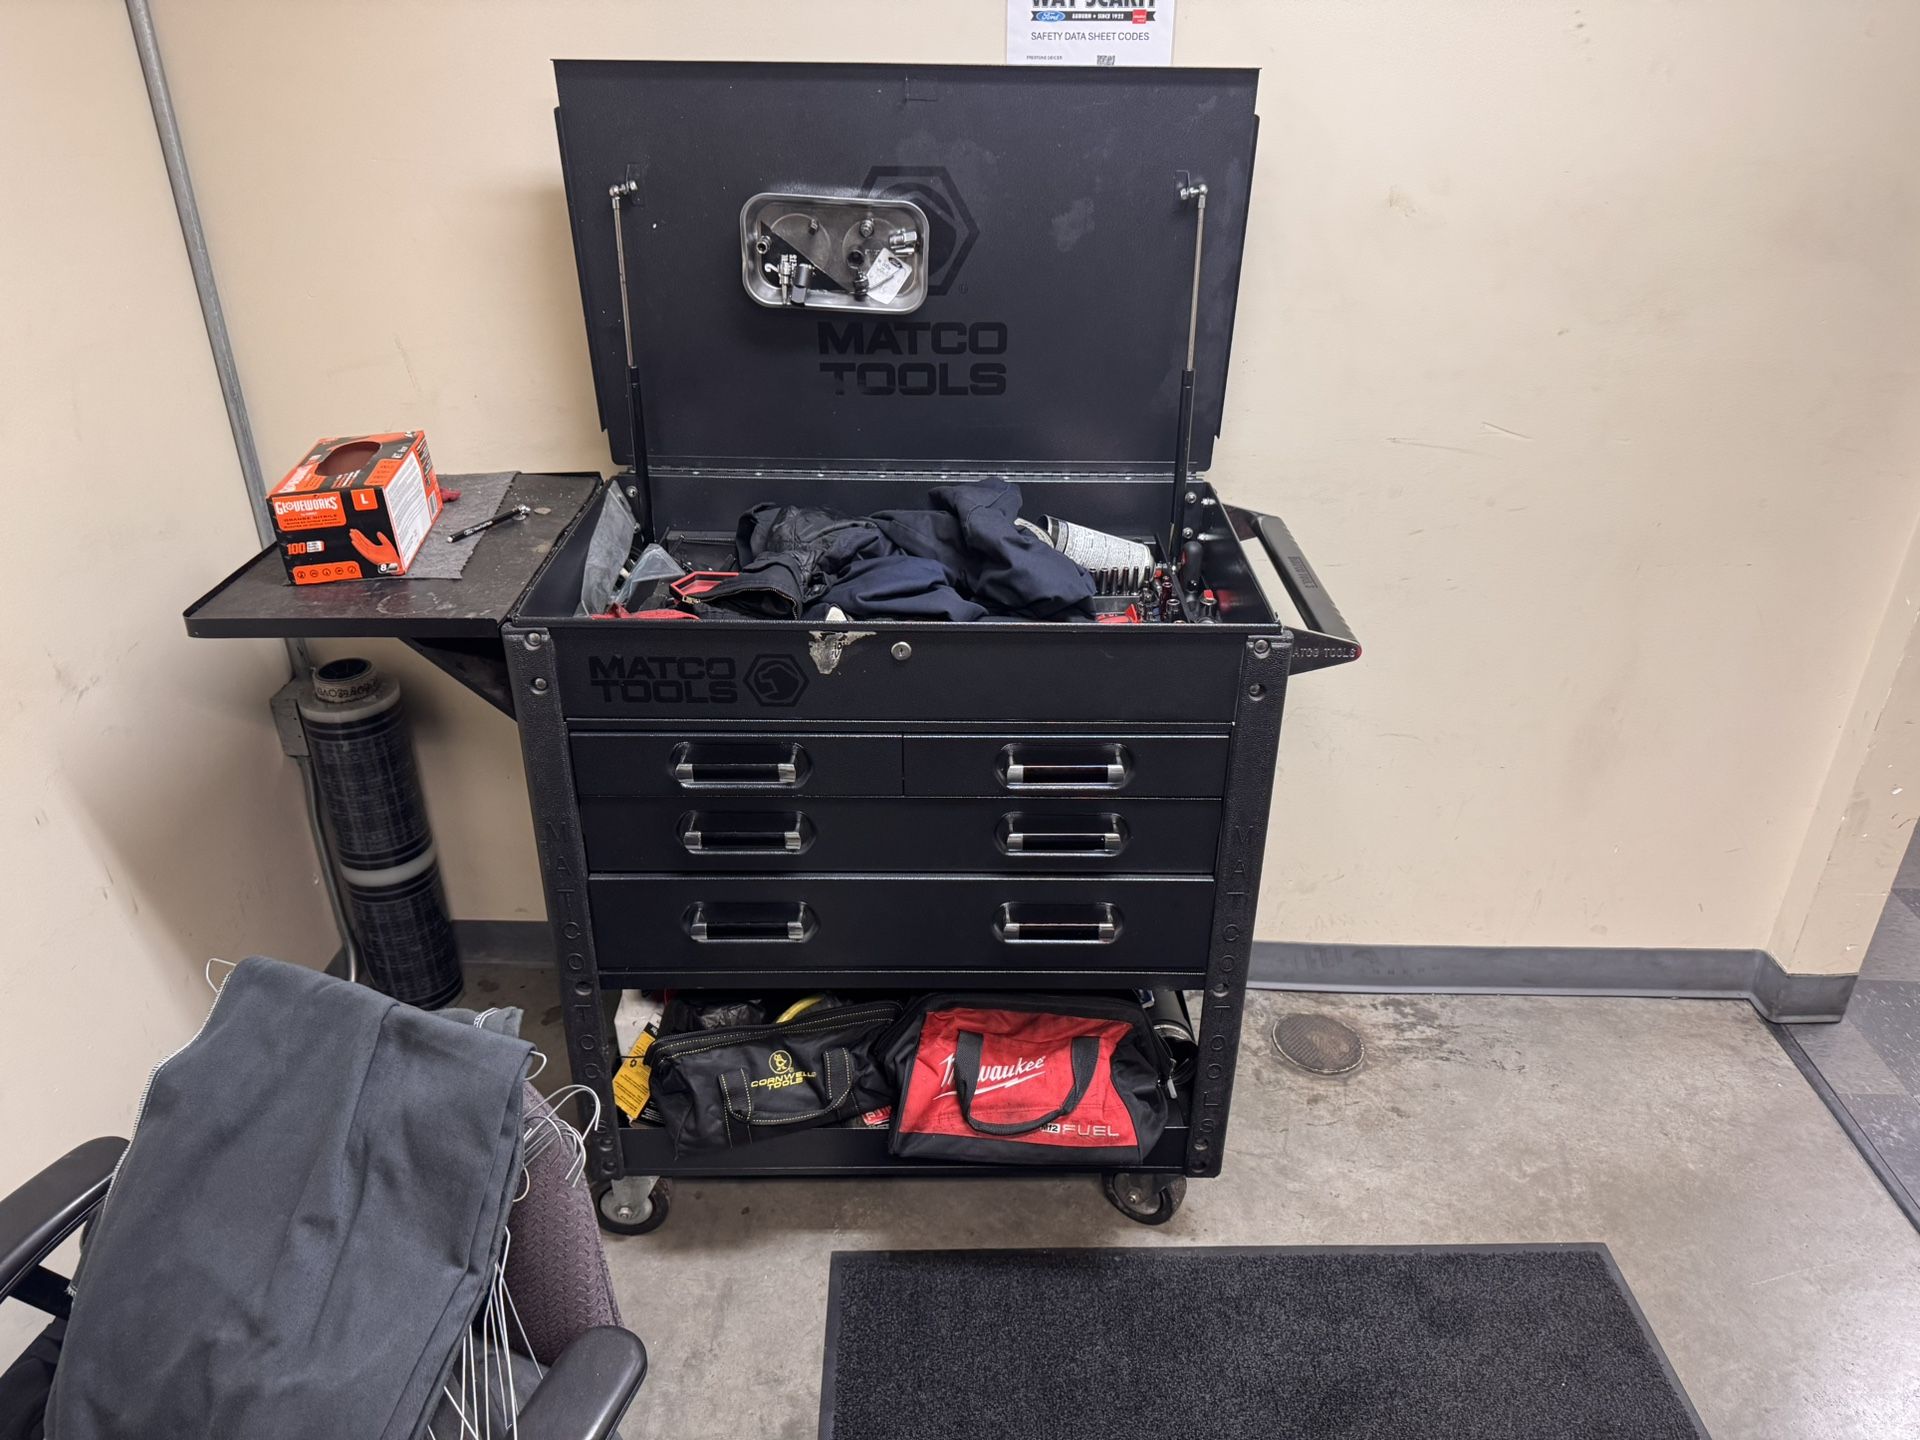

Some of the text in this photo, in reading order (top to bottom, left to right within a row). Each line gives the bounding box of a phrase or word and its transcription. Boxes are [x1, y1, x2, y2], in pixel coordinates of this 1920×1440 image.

[1031, 32, 1150, 41] SAFETY DATA SHEET CODES
[817, 321, 1008, 355] MATCO
[819, 362, 1007, 396] TOOLS
[275, 496, 338, 515] GLOVEWORKS
[359, 493, 369, 505] L
[287, 542, 306, 555] 100
[588, 655, 737, 680] MATCO
[590, 680, 738, 704] TOOLS
[938, 1053, 1046, 1089] Mwaukee
[767, 1077, 804, 1091] TOOLS
[1062, 1123, 1120, 1137] FUEL
